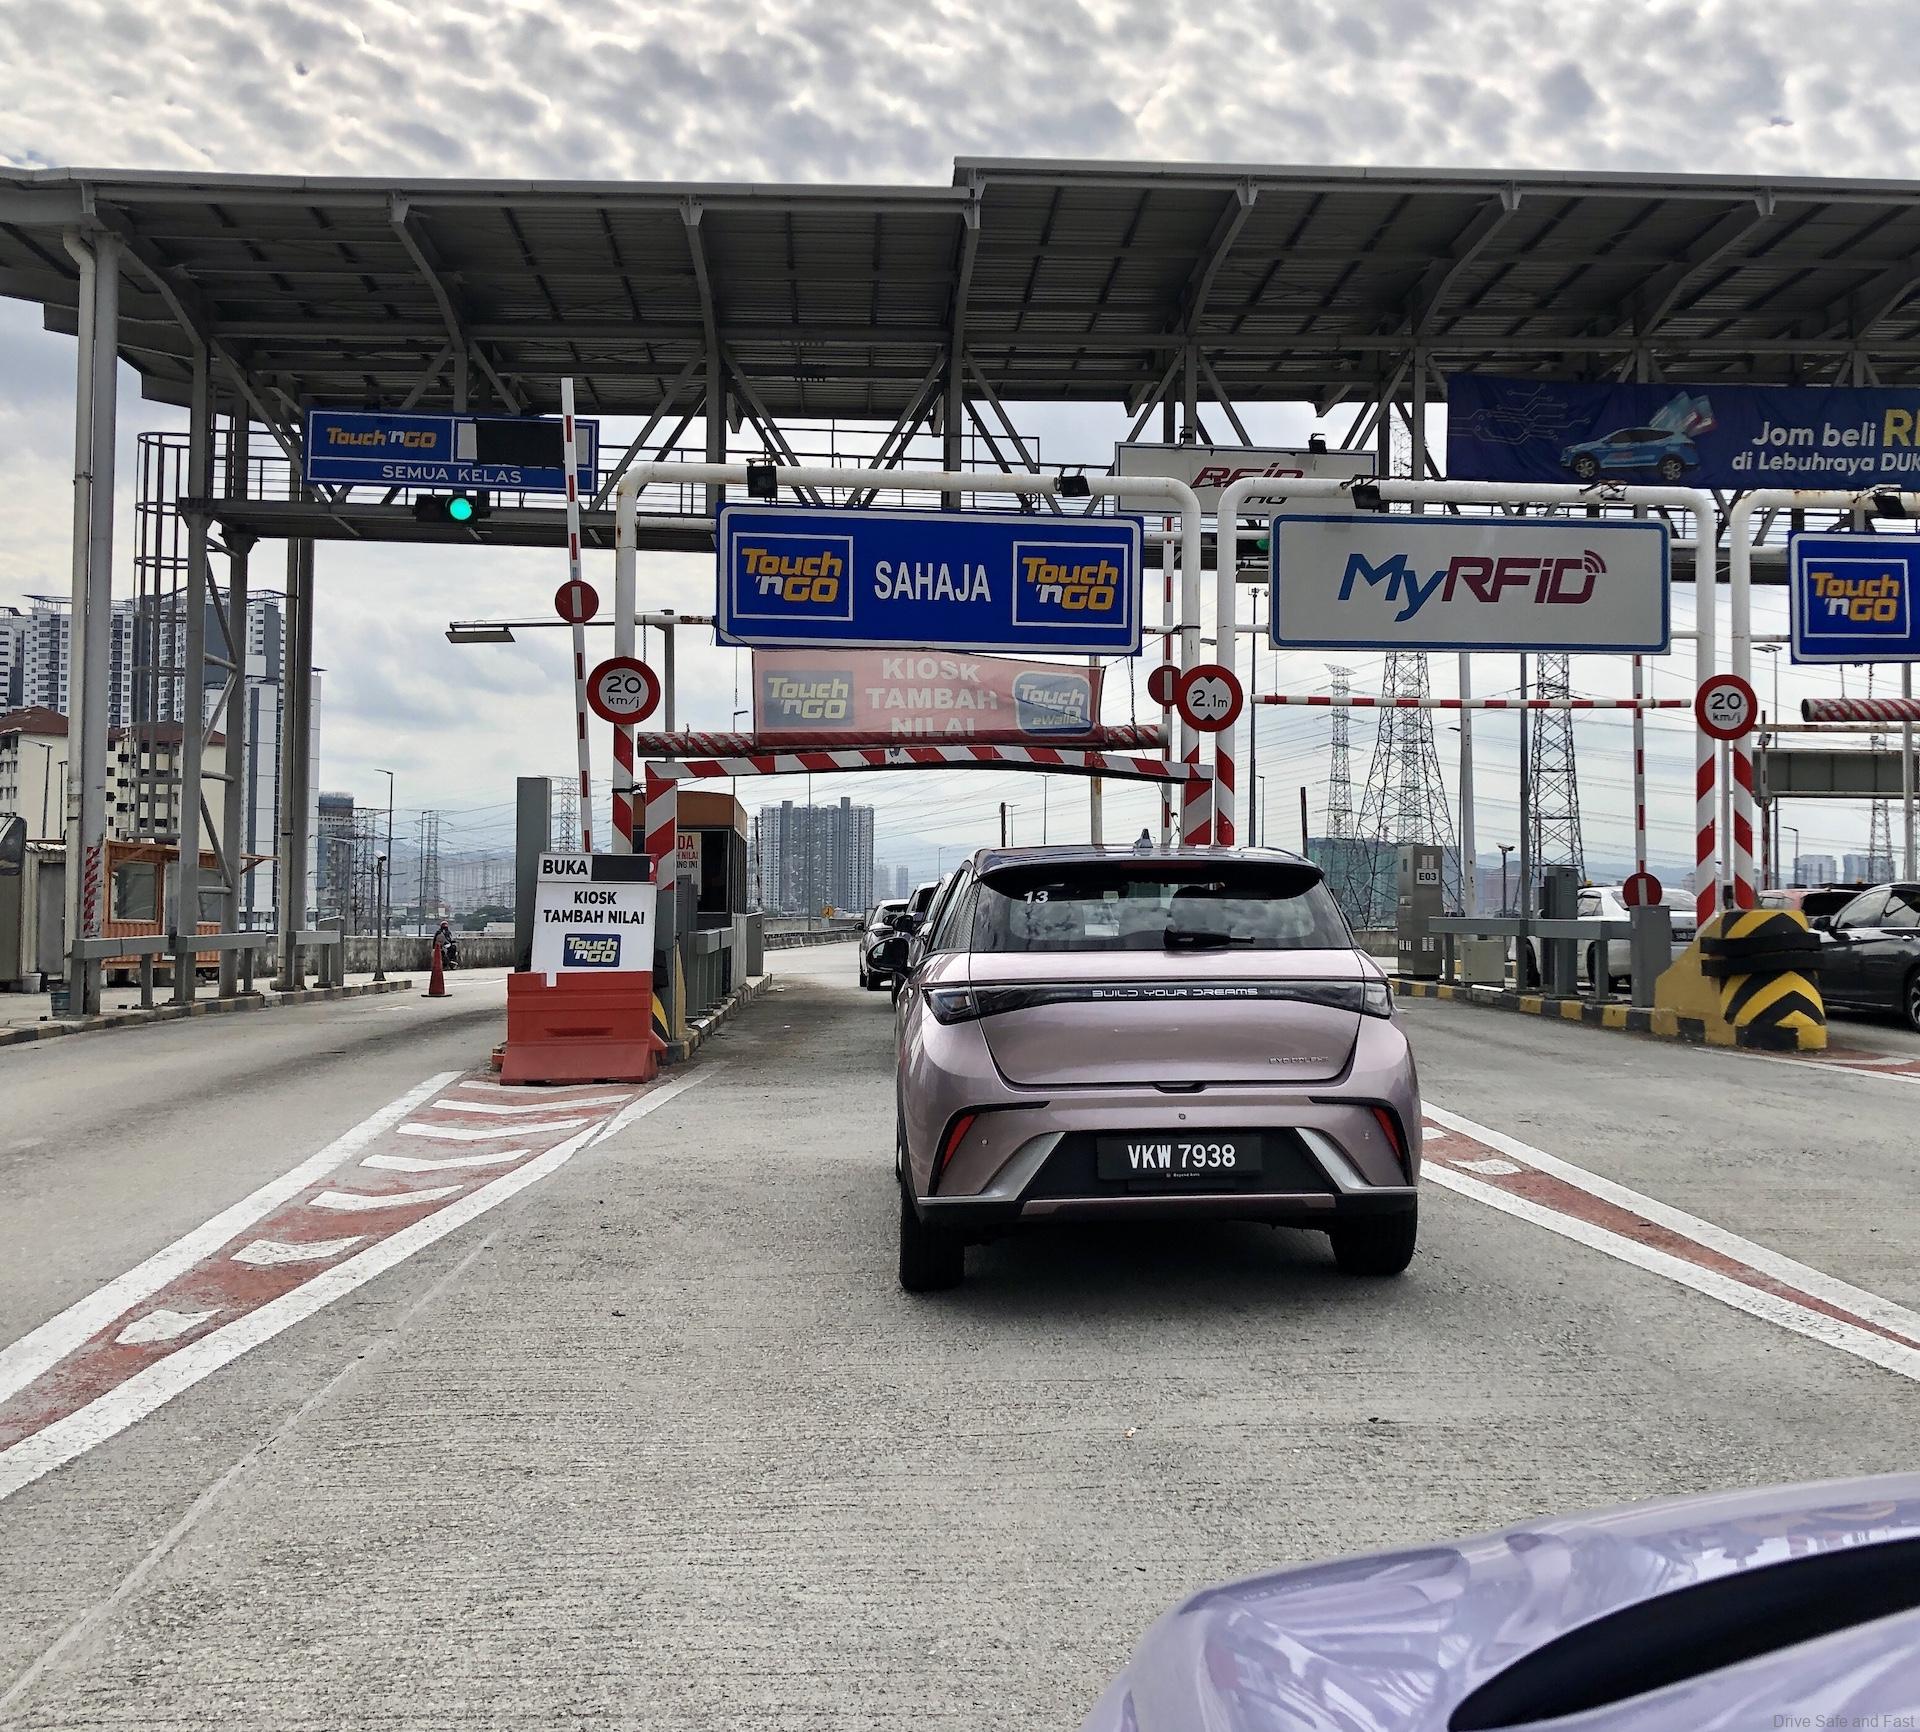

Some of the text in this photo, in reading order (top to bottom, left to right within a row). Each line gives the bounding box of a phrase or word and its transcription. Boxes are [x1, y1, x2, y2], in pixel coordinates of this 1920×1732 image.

[326, 427, 387, 446] Touch
[1752, 421, 1814, 446] Jom
[1822, 422, 1876, 447] beli
[1732, 451, 1754, 470] di
[1758, 451, 1875, 477] Lebuhraya
[382, 465, 522, 484] SEMUA KELAS
[742, 548, 843, 577] Touch
[1022, 557, 1119, 585] Touch
[874, 560, 992, 602] SAHAJA
[1810, 572, 1899, 597] Touch
[882, 657, 982, 682] KIOSK
[607, 675, 642, 694] 20
[767, 677, 849, 699] Touch
[608, 695, 640, 709] km/j
[865, 687, 998, 710] TAMBAH
[1020, 683, 1085, 707] Touch
[1711, 692, 1742, 710] 20
[890, 716, 976, 738] NILAI
[542, 859, 588, 875] BUKA
[1418, 872, 1437, 881] E03
[573, 890, 618, 905] KIOSK
[1024, 890, 1049, 905] 13
[543, 909, 645, 924] TAMBAH NILAI
[566, 937, 618, 951] Touch
[1092, 988, 1258, 998] BUILD YOUR DREAMS
[1127, 1143, 1236, 1169] VKW 7938
